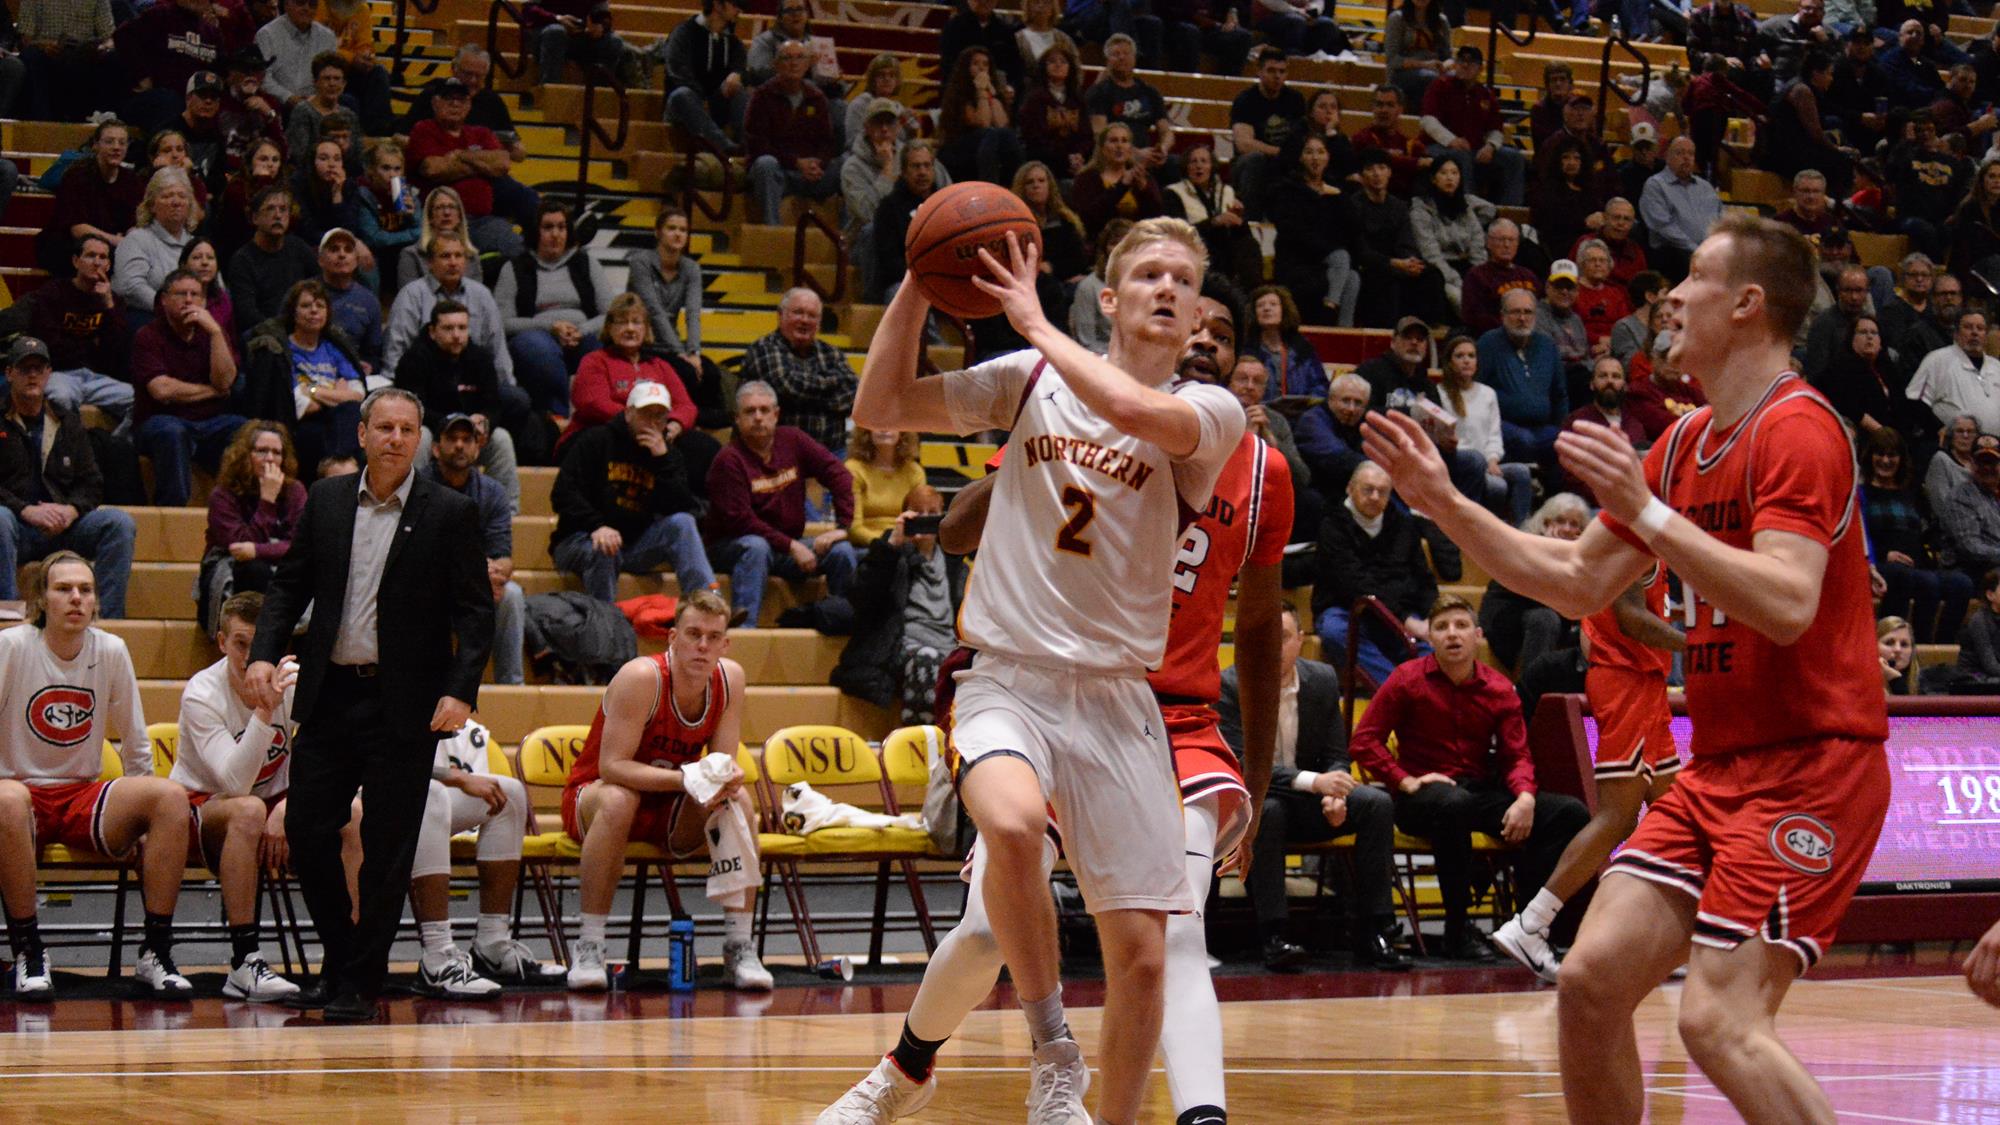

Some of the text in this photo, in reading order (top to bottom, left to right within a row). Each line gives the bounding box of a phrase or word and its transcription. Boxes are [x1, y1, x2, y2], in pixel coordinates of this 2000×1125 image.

[1024, 434, 1154, 491] NORTHERN
[1055, 484, 1095, 557] 2
[784, 736, 856, 774] NSU
[1896, 881, 1951, 891] DAKTRONICS
